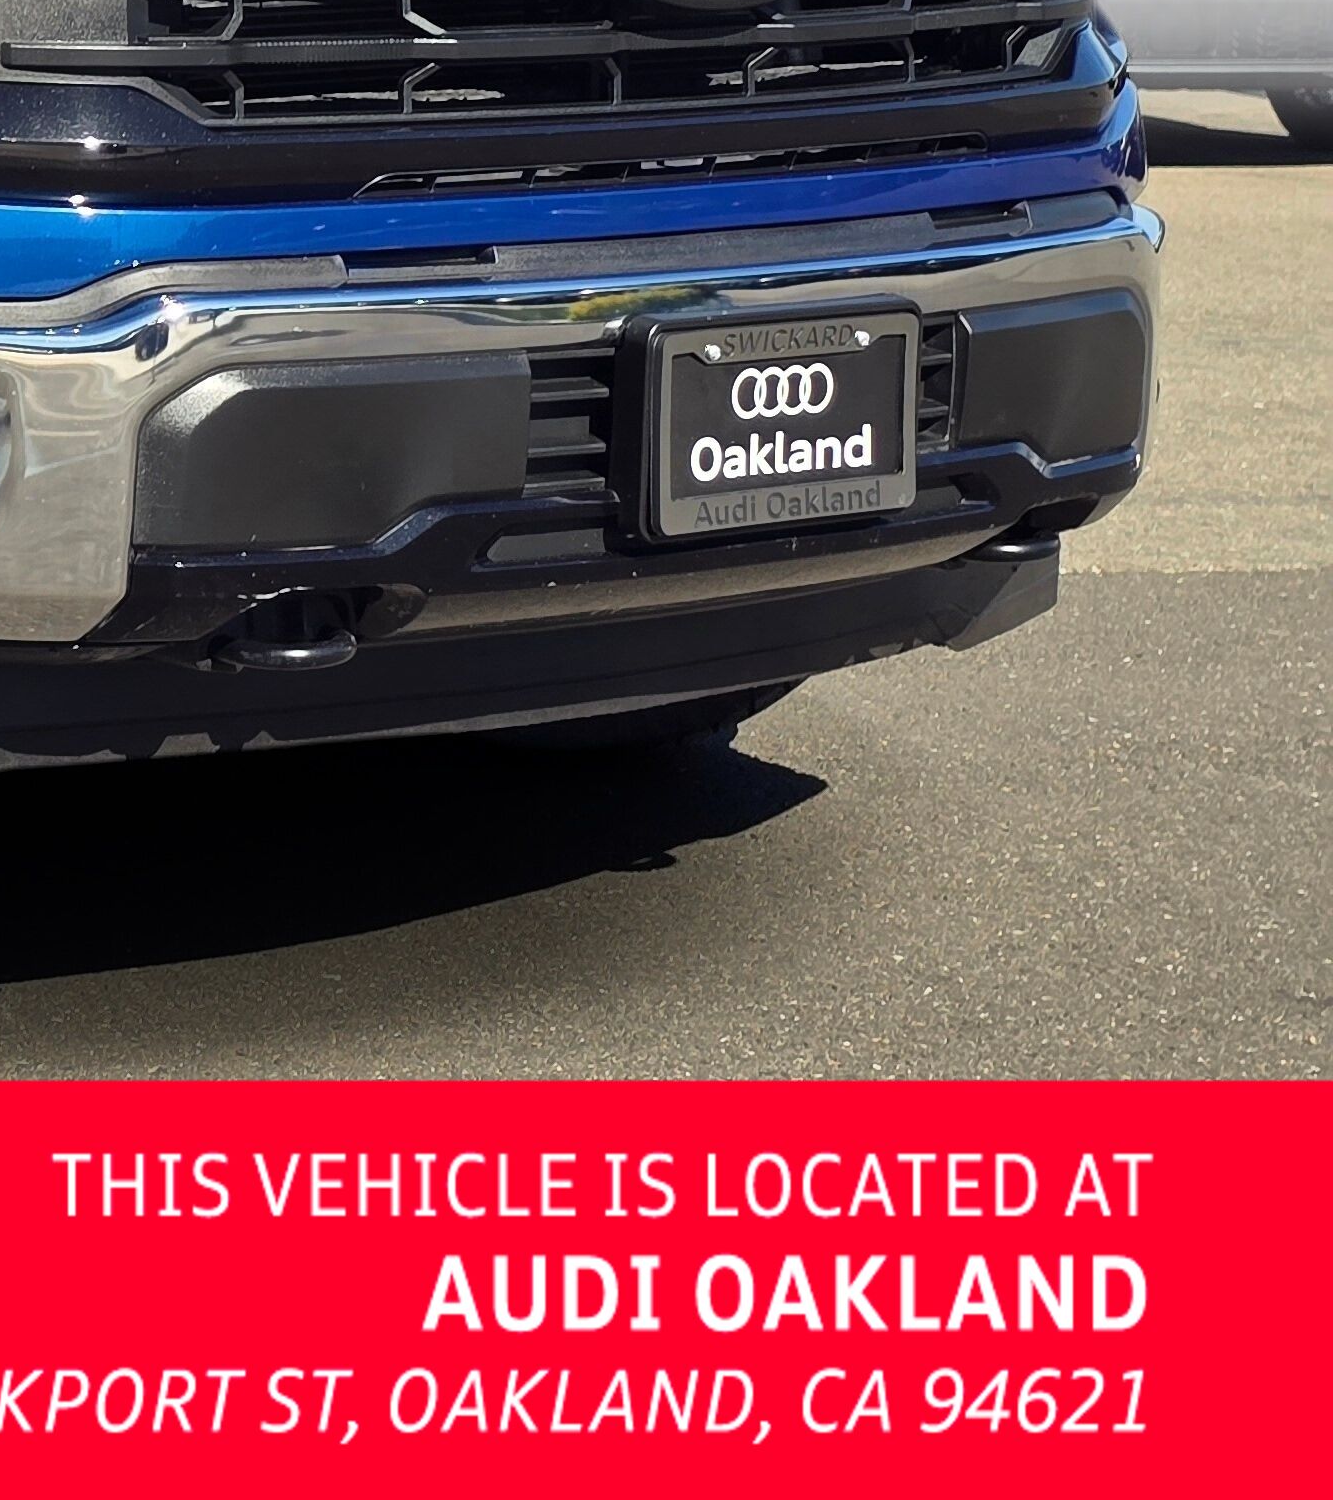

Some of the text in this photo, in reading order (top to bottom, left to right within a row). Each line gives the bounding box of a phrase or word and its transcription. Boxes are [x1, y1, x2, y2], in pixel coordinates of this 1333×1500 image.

[722, 323, 854, 357] SWICKARD
[690, 423, 873, 482] Oakland
[694, 480, 881, 528] Audi Oakland
